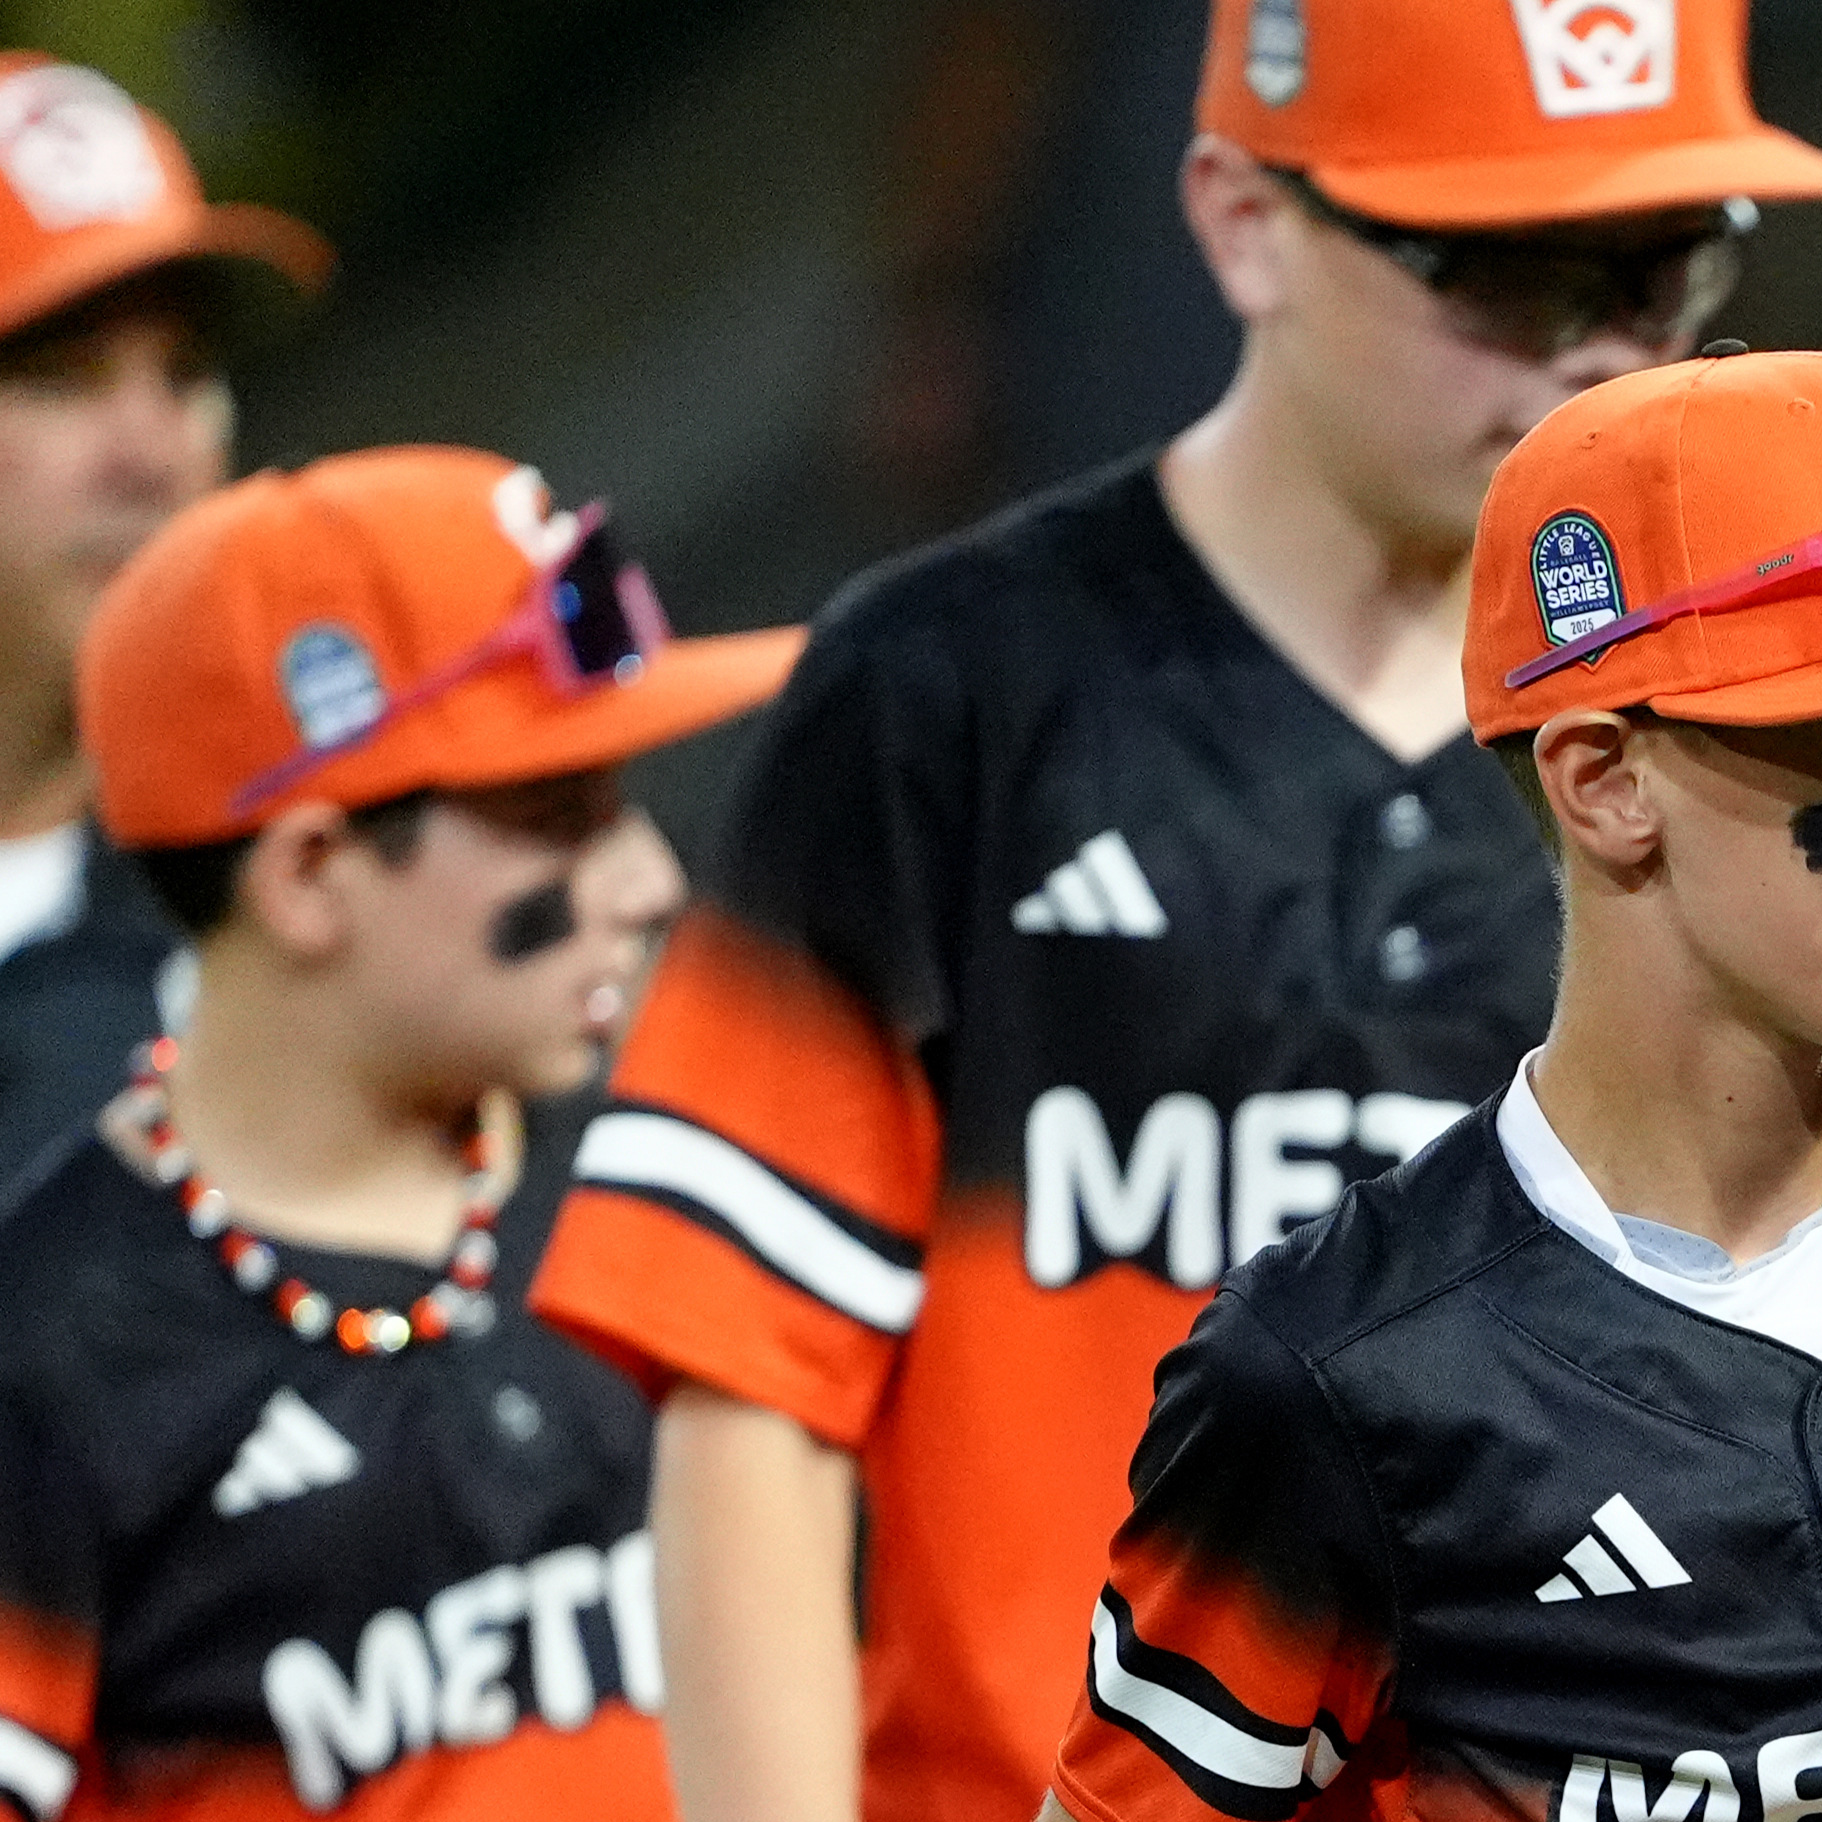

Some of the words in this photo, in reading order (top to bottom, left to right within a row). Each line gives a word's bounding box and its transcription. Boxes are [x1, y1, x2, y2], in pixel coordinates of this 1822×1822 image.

[1538, 528, 1560, 570] LITTLE
[1564, 523, 1601, 559] LEAGUE
[1539, 560, 1608, 589] WORLD
[1757, 554, 1794, 576] goodr
[1545, 579, 1610, 609] SERIES
[1570, 618, 1594, 635] 2025
